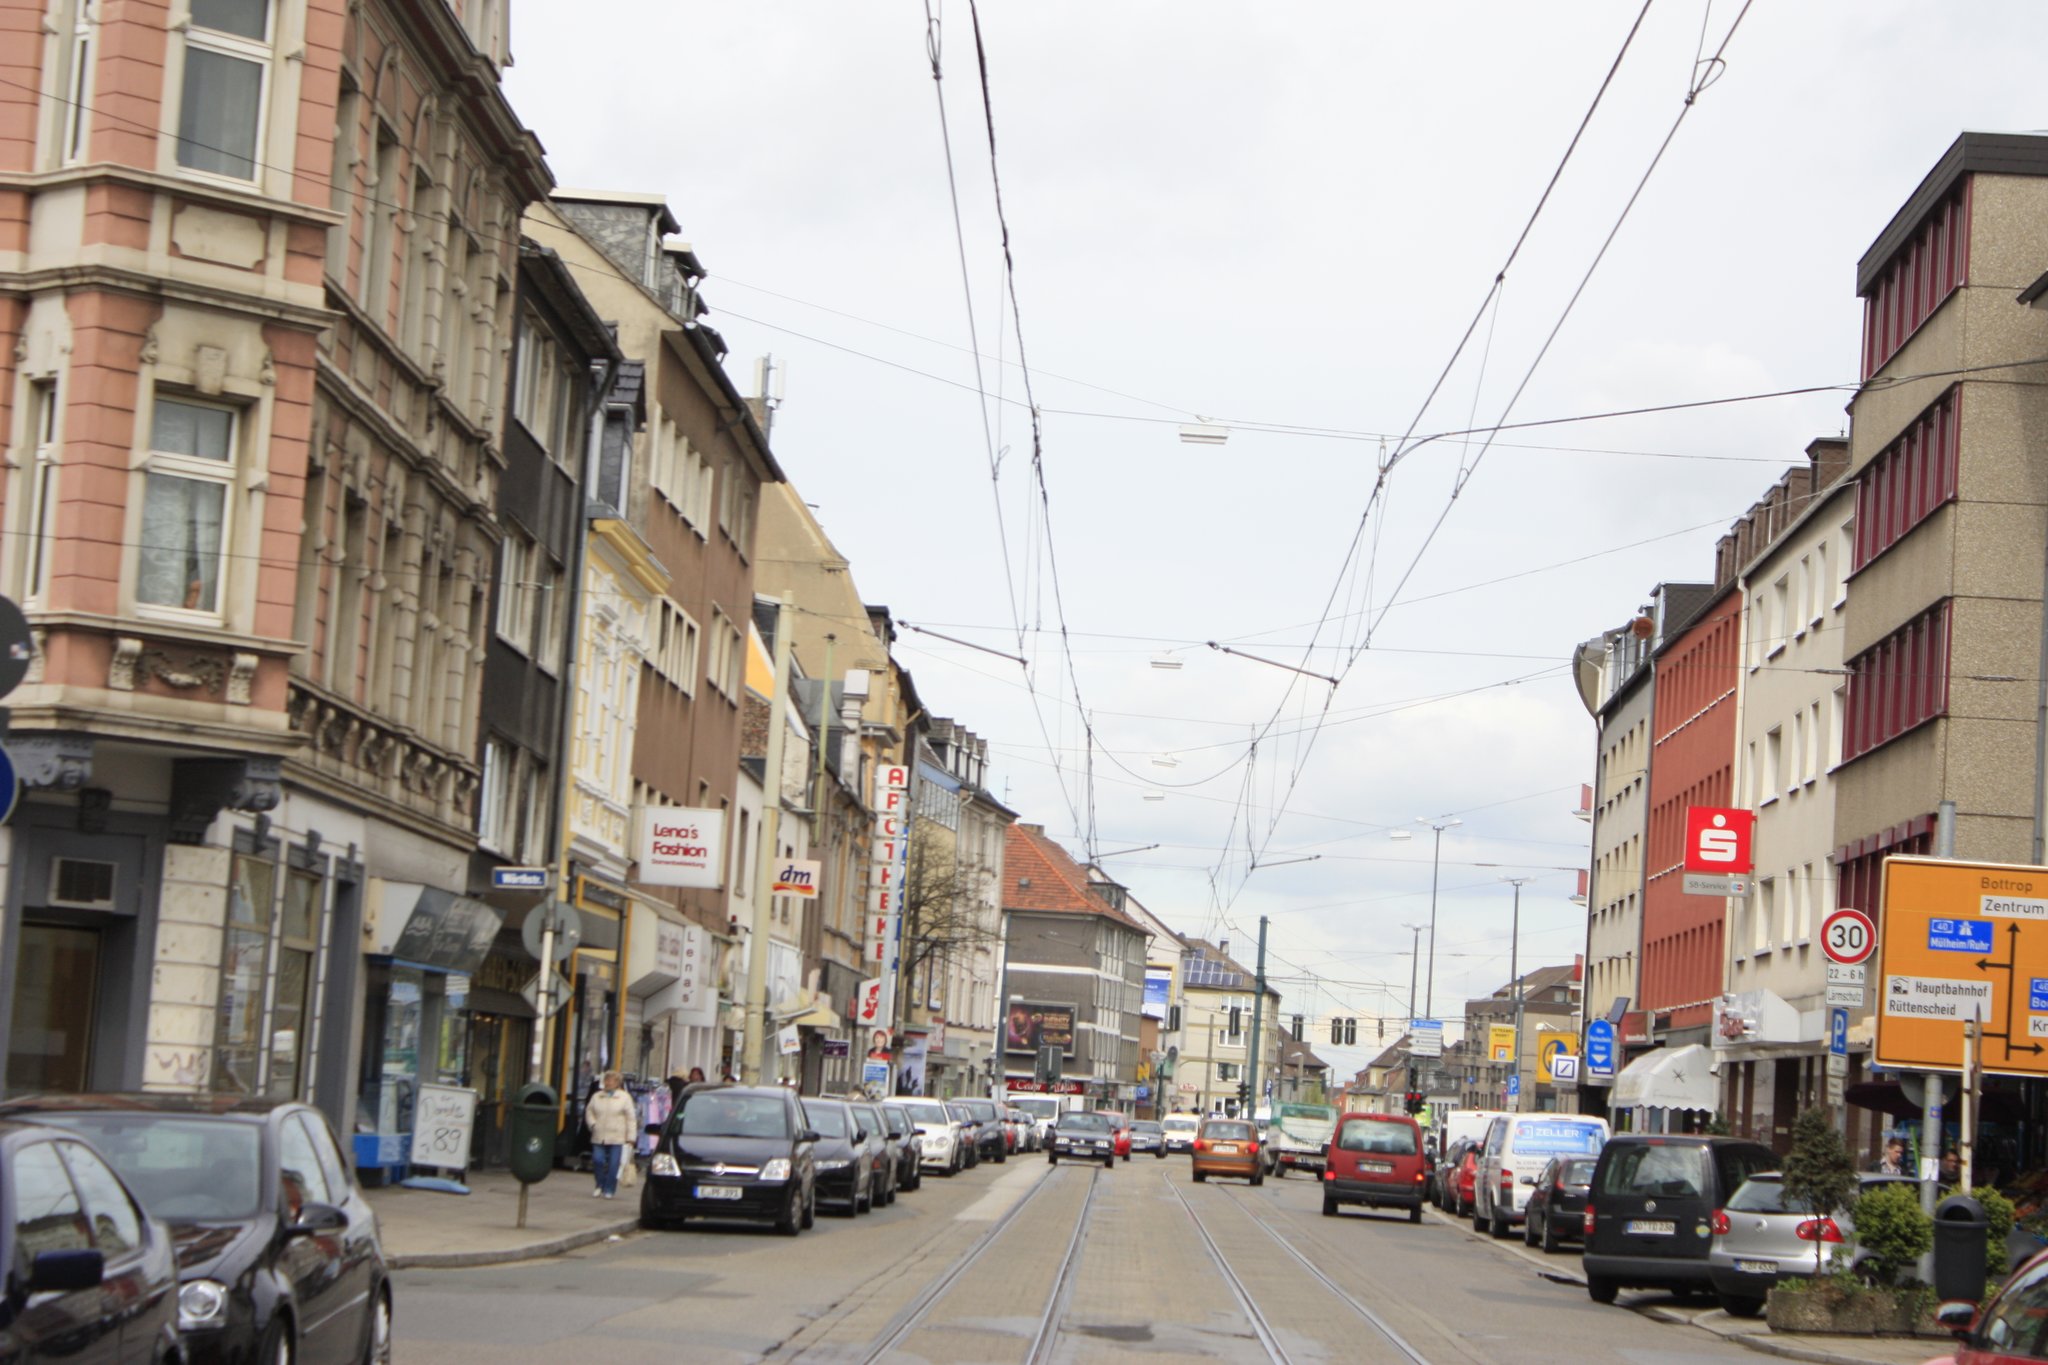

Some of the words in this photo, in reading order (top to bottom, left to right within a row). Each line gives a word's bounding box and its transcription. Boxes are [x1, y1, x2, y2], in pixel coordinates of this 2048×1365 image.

[652, 841, 707, 858] Fashion
[780, 864, 811, 884] dm
[1688, 880, 1728, 890] SB-Service
[1981, 877, 2033, 894] Bottrop
[1985, 899, 2045, 915] Zentrum
[1832, 925, 1863, 949] 30
[1828, 968, 1839, 979] 22
[1850, 969, 1856, 980] 6
[1858, 969, 1865, 980] h
[1916, 981, 1987, 998] Hauptbahnhof
[1889, 1000, 1956, 1016] Rüttenscheid
[1834, 1013, 1844, 1048] P
[1536, 1128, 1579, 1138] ZELLER
